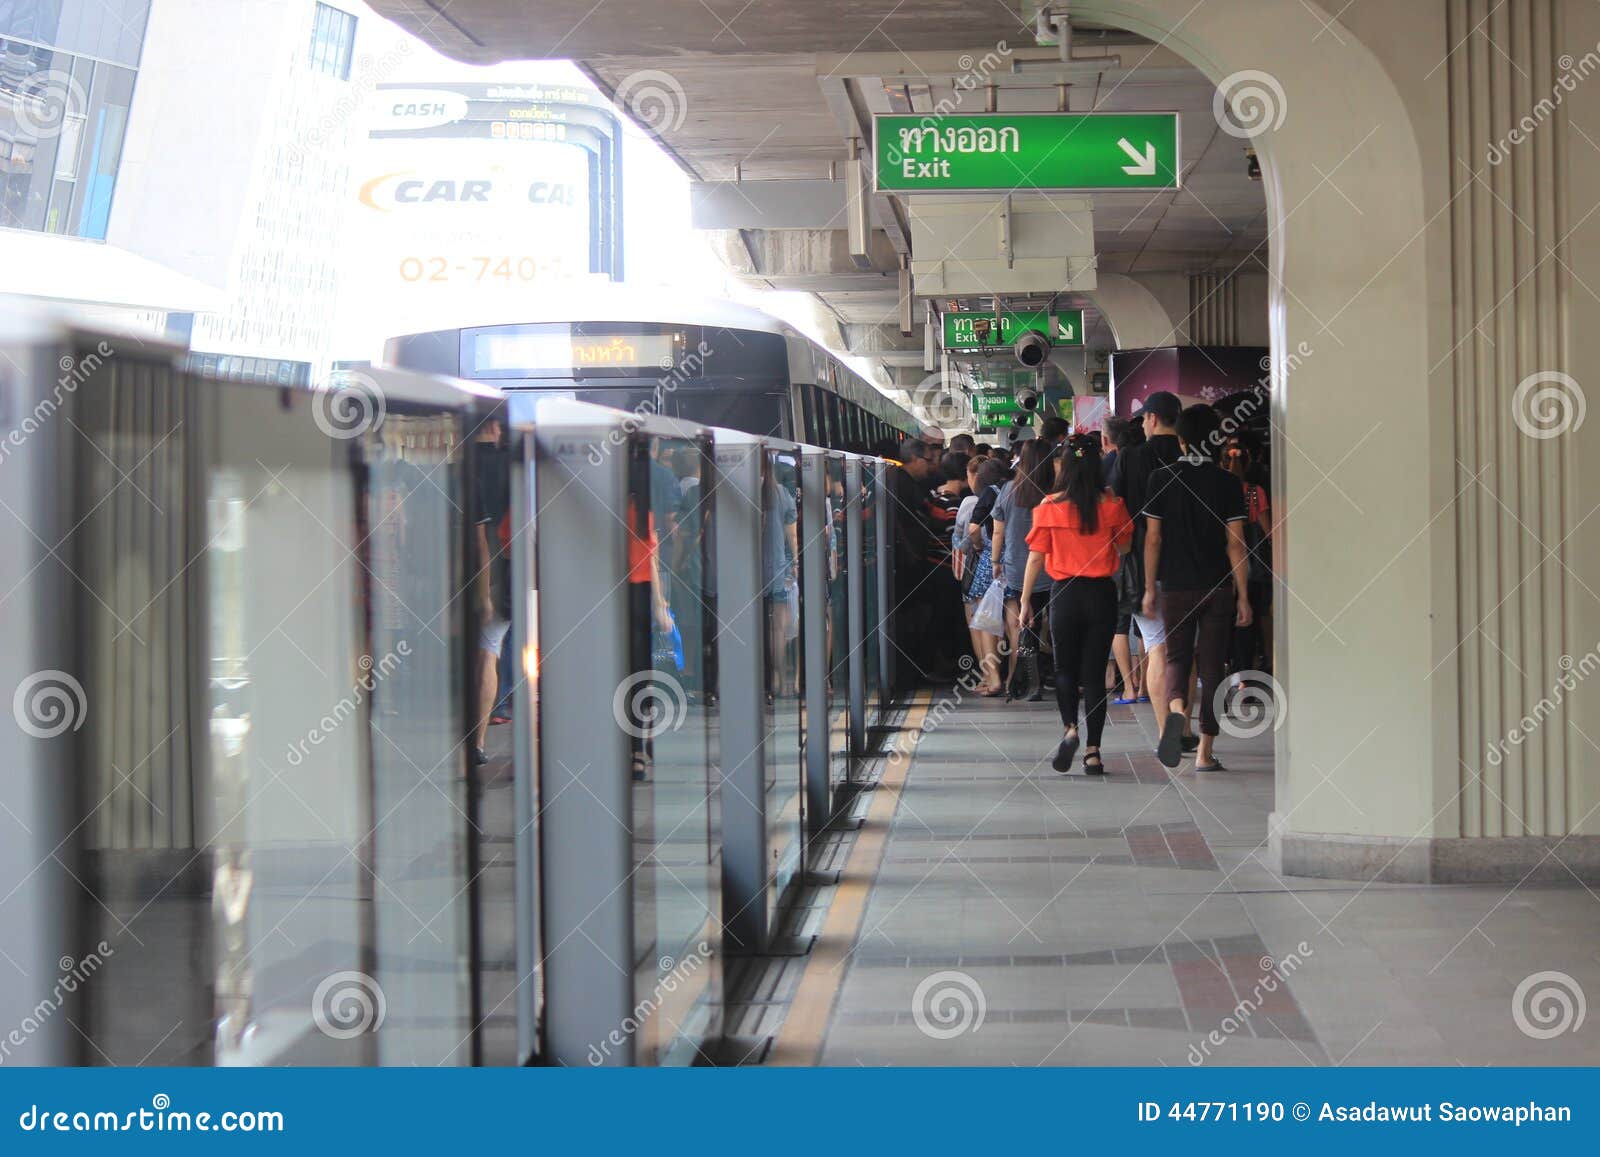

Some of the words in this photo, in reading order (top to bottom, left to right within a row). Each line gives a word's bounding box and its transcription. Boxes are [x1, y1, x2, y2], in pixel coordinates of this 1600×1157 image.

[391, 103, 446, 116] CASH
[899, 126, 1020, 153] ทางออก
[903, 157, 951, 178] Exit
[394, 180, 493, 203] CAR
